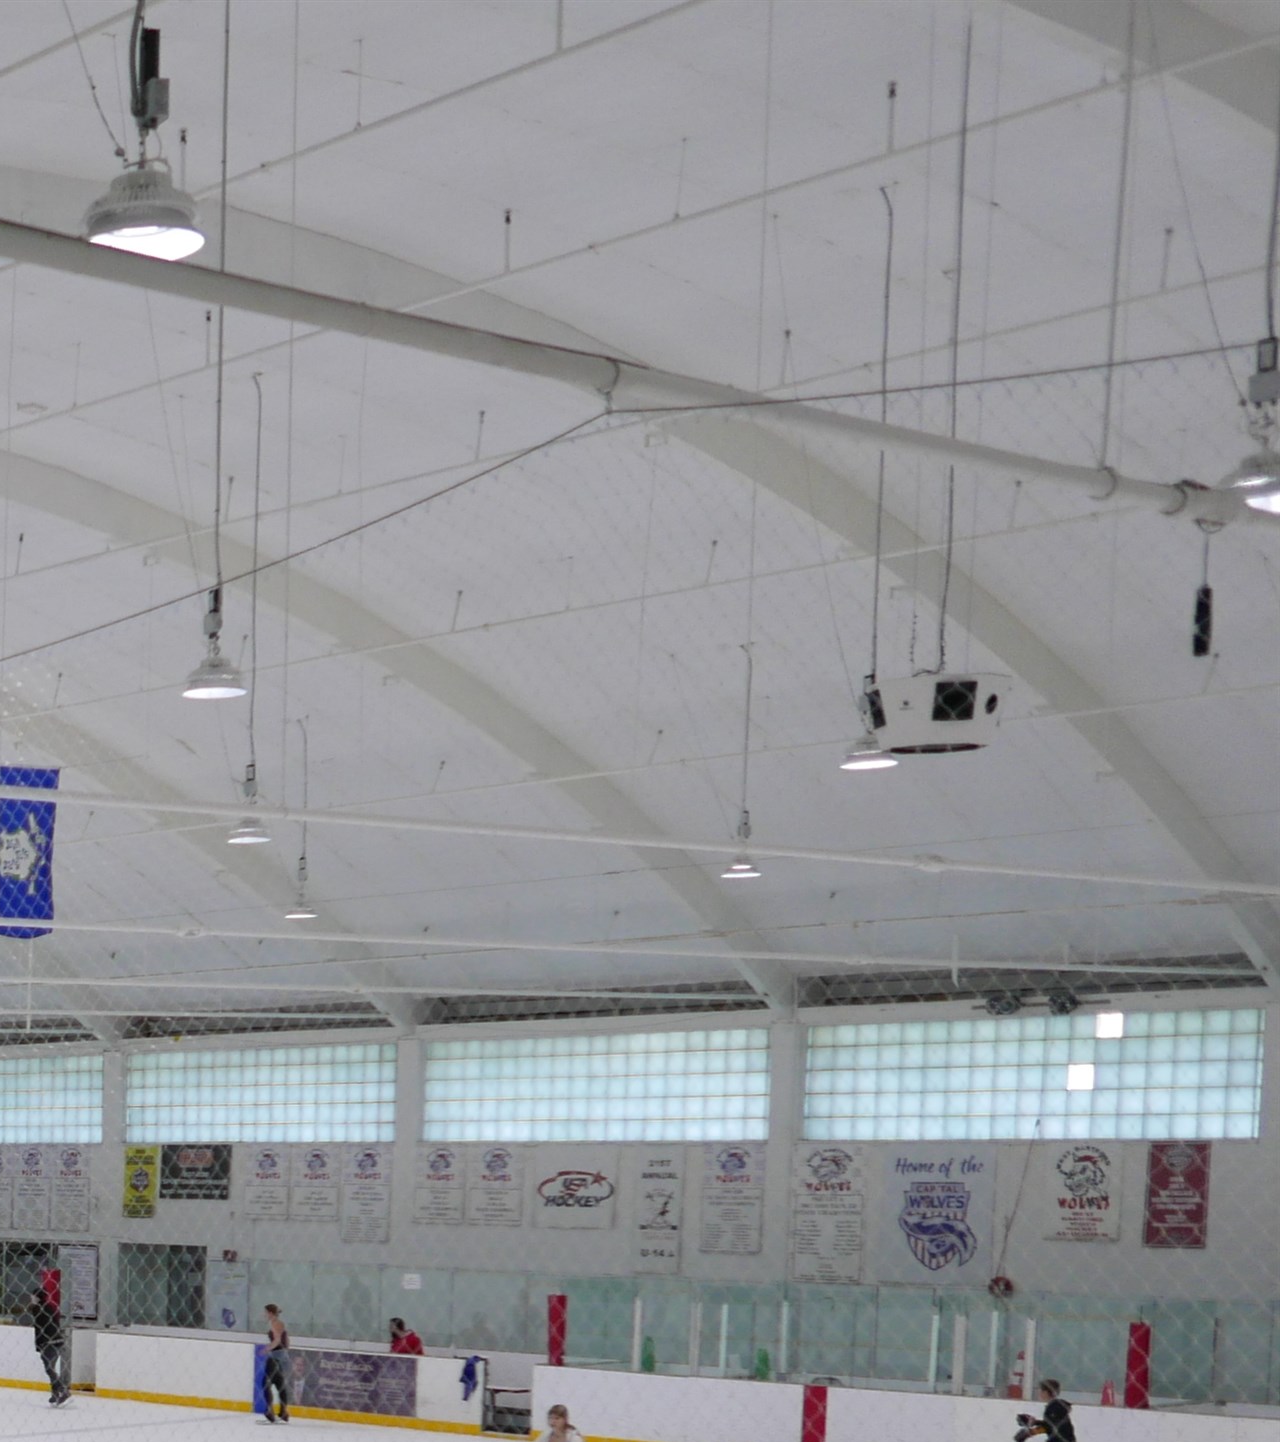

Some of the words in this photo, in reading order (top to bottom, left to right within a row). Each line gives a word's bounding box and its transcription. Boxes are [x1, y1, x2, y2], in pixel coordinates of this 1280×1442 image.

[896, 1157, 935, 1175] Home
[939, 1157, 954, 1179] of
[961, 1155, 984, 1174] the
[915, 1185, 958, 1193] CAPTAL
[543, 1195, 601, 1208] HOCKEY
[909, 1195, 965, 1208] WOLVES
